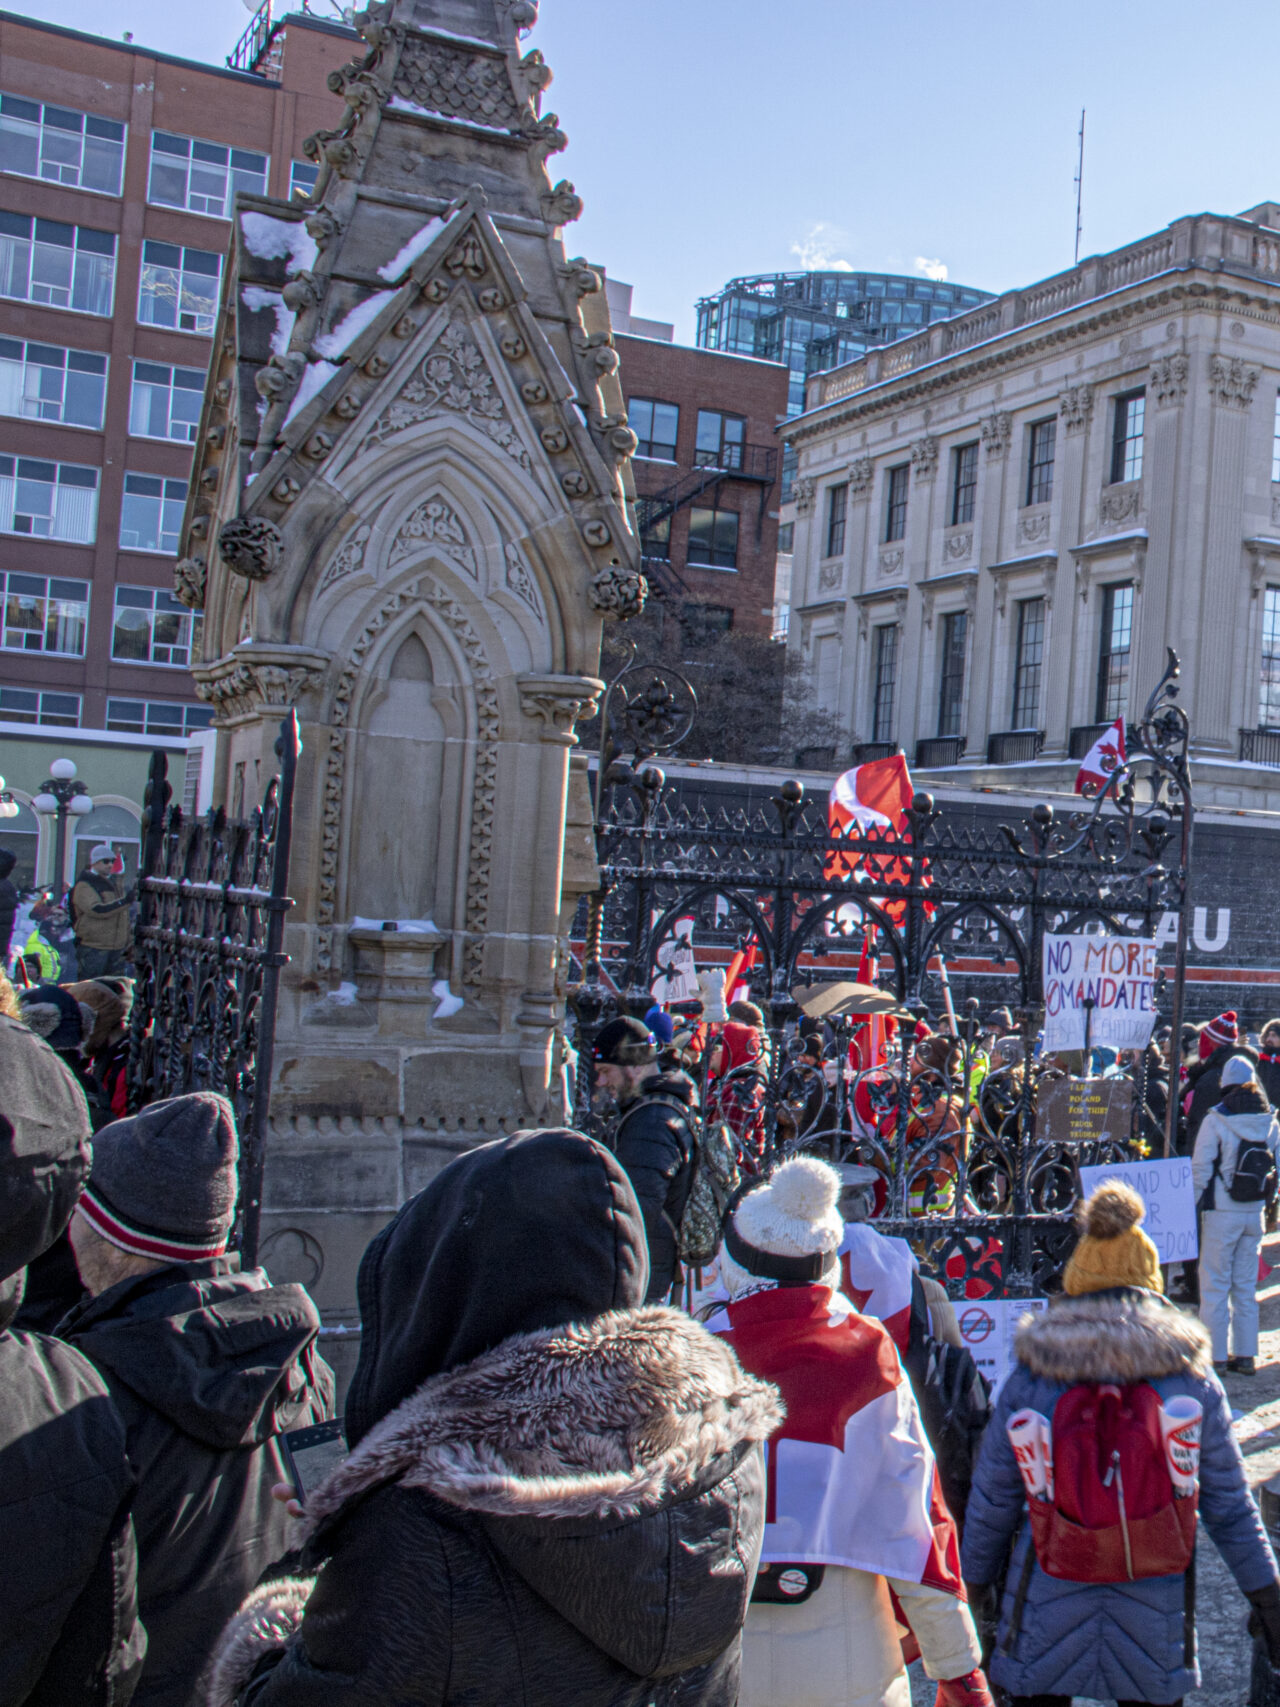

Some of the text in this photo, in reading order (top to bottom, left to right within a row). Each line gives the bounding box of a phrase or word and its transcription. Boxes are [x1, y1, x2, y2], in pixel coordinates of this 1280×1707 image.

[1047, 940, 1156, 977] NO MORE
[1169, 1166, 1191, 1189] UP
